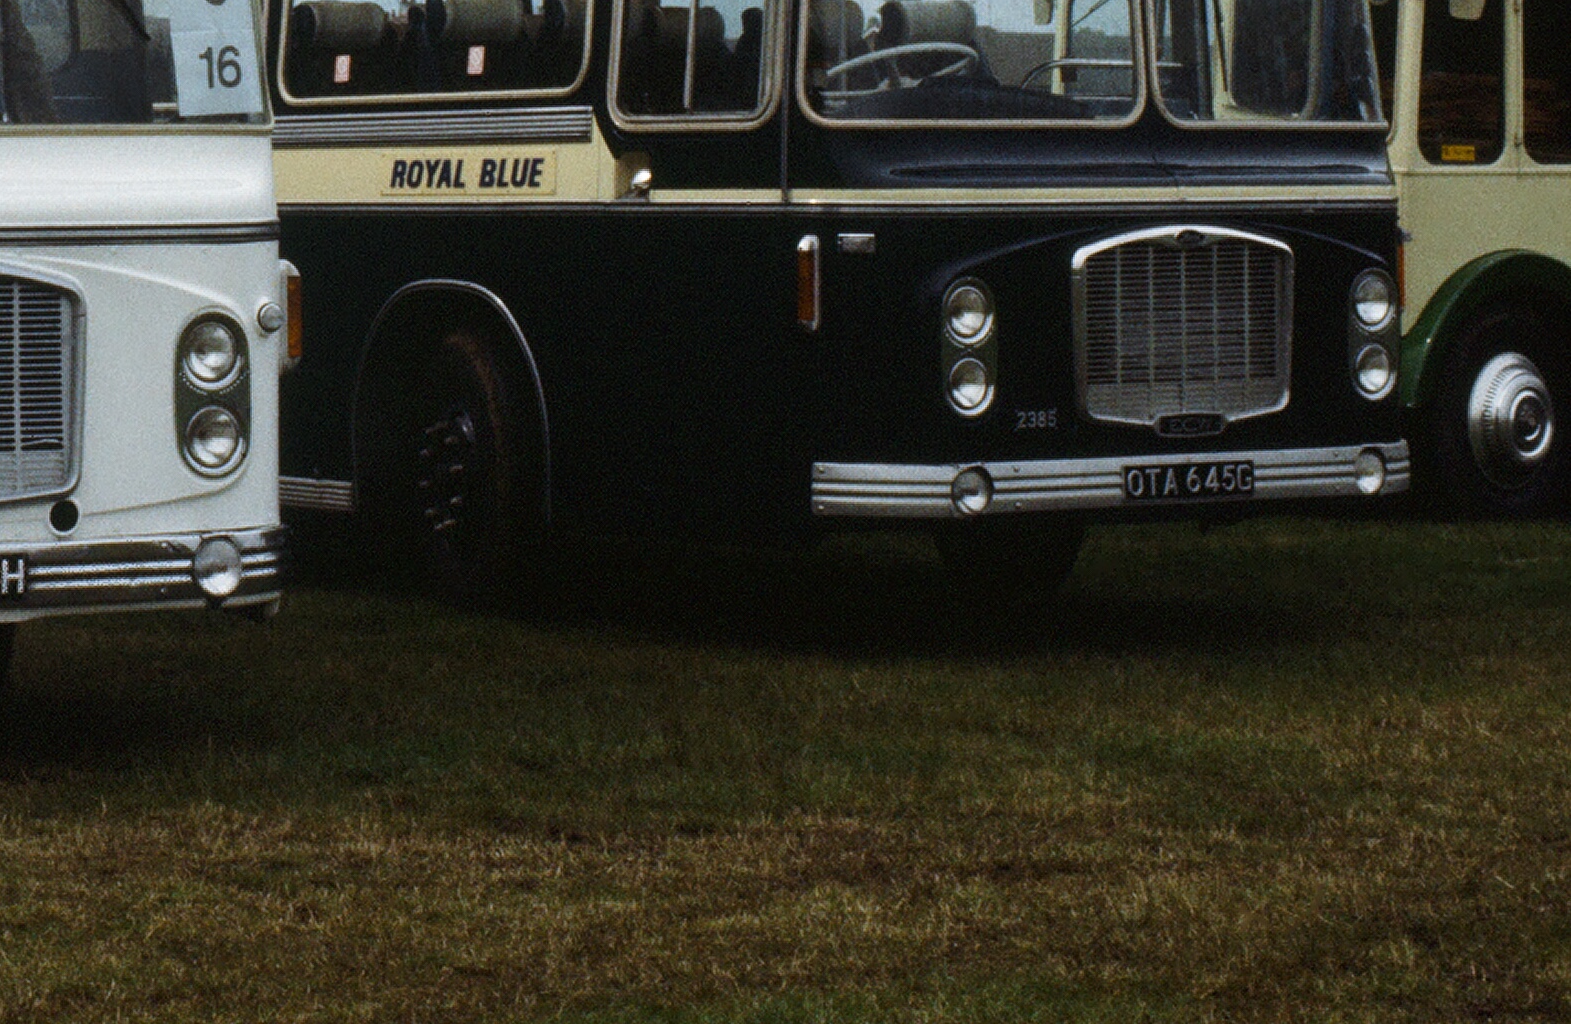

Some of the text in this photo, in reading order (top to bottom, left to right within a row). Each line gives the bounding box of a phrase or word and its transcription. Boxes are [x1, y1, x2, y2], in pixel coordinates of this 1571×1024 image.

[198, 44, 242, 90] 16
[389, 157, 545, 190] ROYAL BLUE
[1126, 463, 1252, 496] OTA 645G
